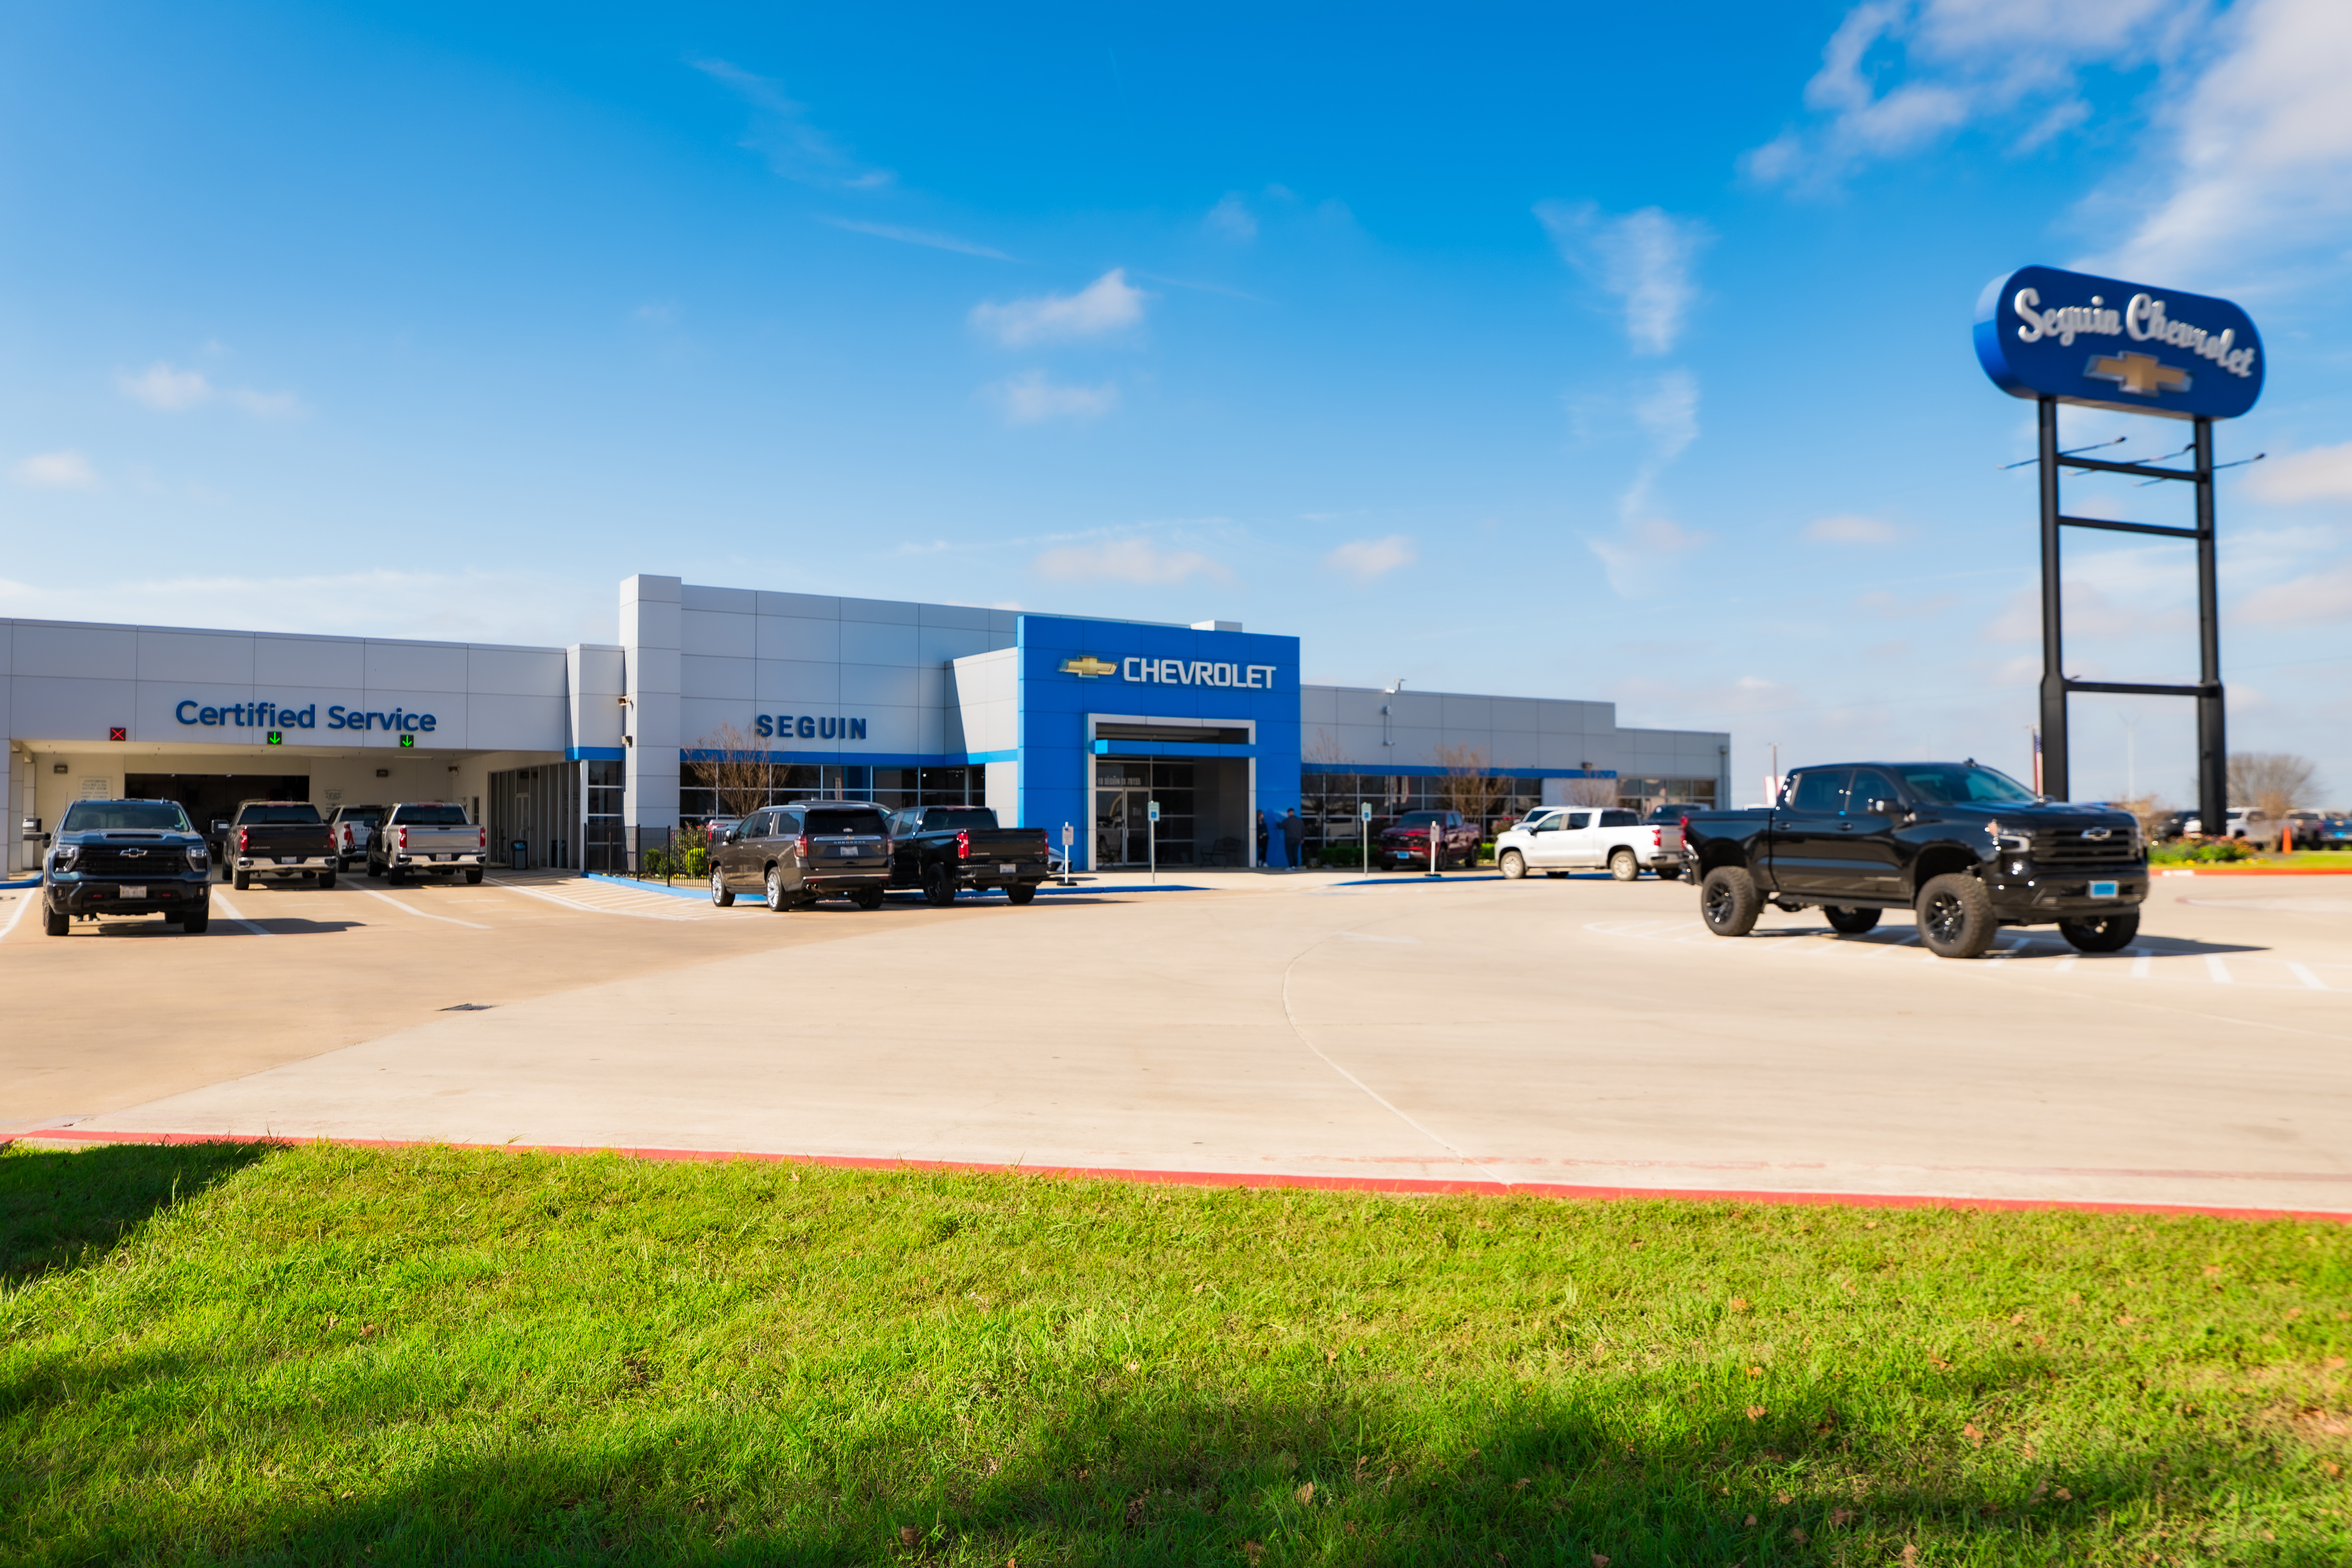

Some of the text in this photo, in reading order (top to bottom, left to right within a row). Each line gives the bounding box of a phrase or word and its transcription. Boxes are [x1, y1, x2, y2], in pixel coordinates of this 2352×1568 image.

[2014, 288, 2256, 377] Seguin Chevrolet
[1124, 657, 1276, 688] CHEVROLET
[176, 700, 437, 731] Certified Service
[757, 715, 866, 739] SEGUIN
